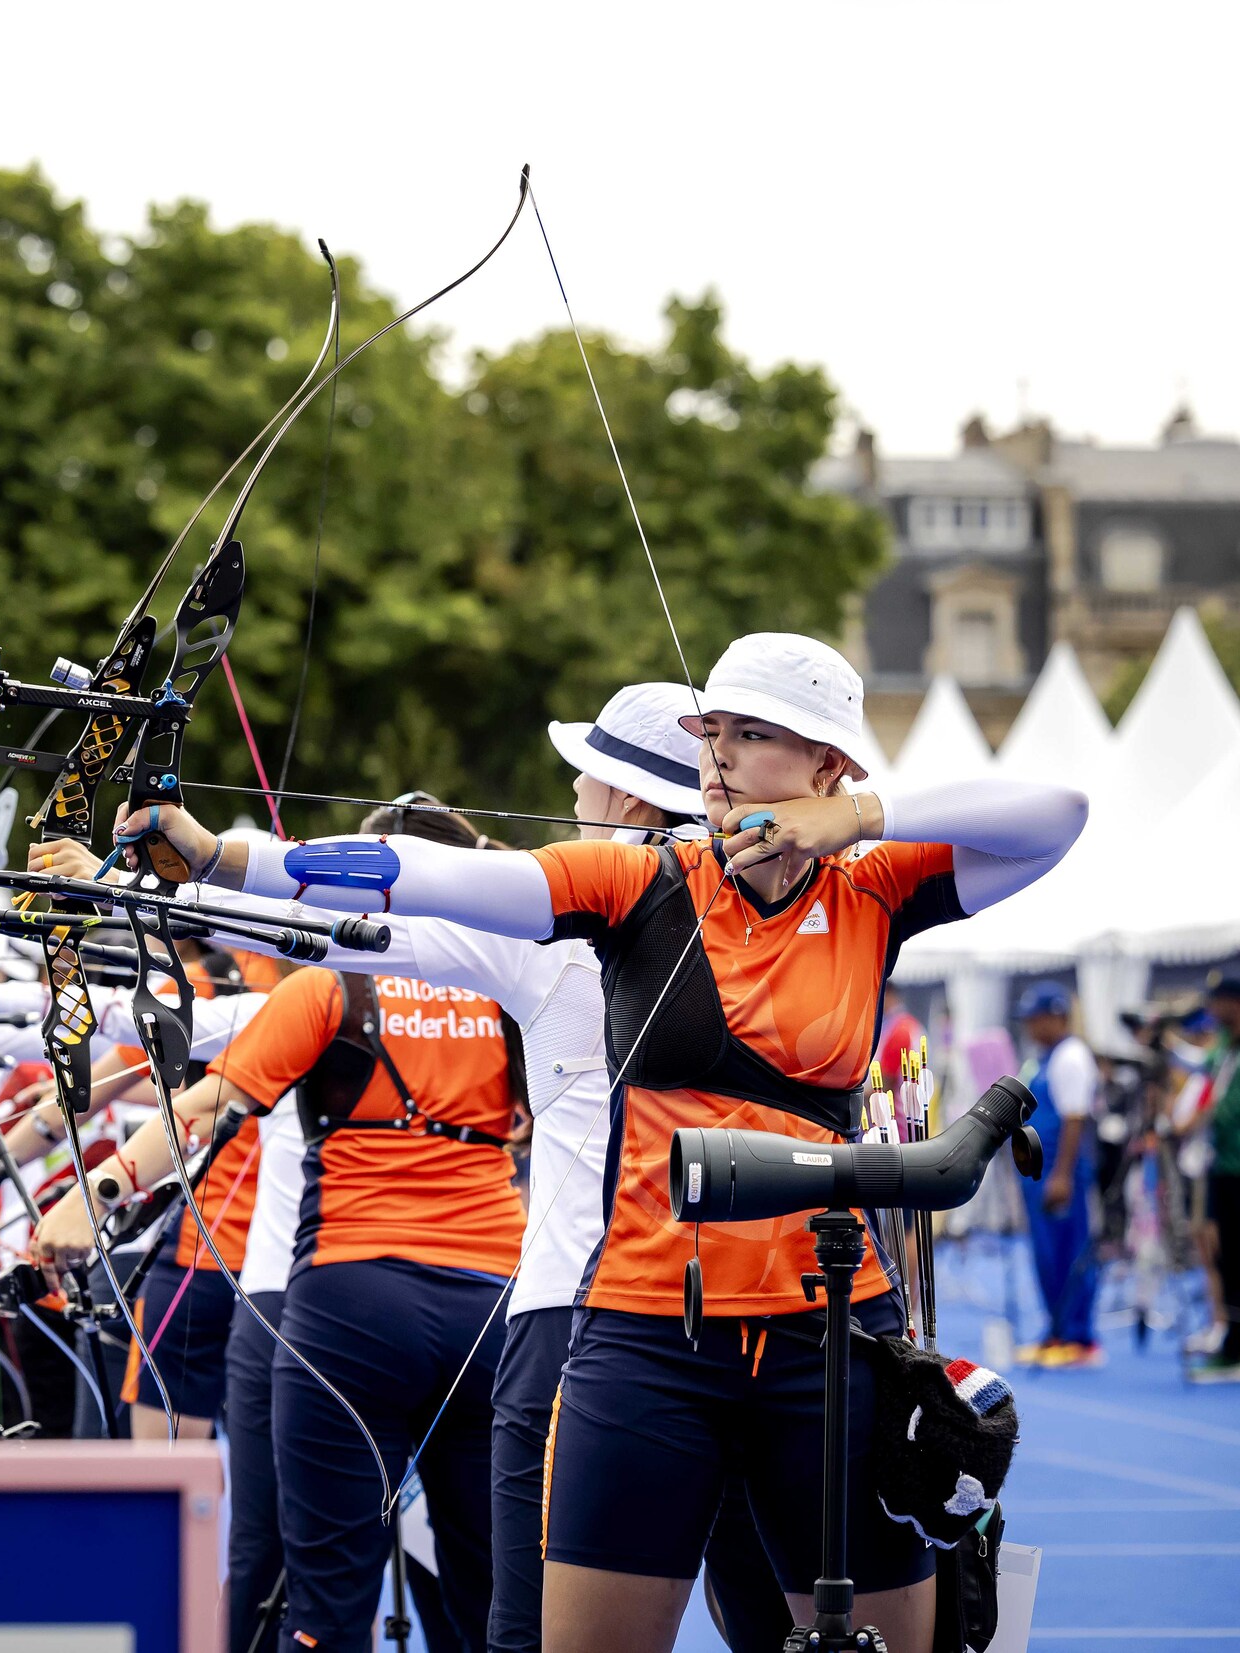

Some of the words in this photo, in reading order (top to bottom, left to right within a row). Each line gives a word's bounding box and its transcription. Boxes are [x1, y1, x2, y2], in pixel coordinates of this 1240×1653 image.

[78, 698, 112, 708] AXCEL
[373, 976, 491, 1003] chloess
[801, 1155, 829, 1164] LAURA
[691, 1172, 699, 1200] LAURA
